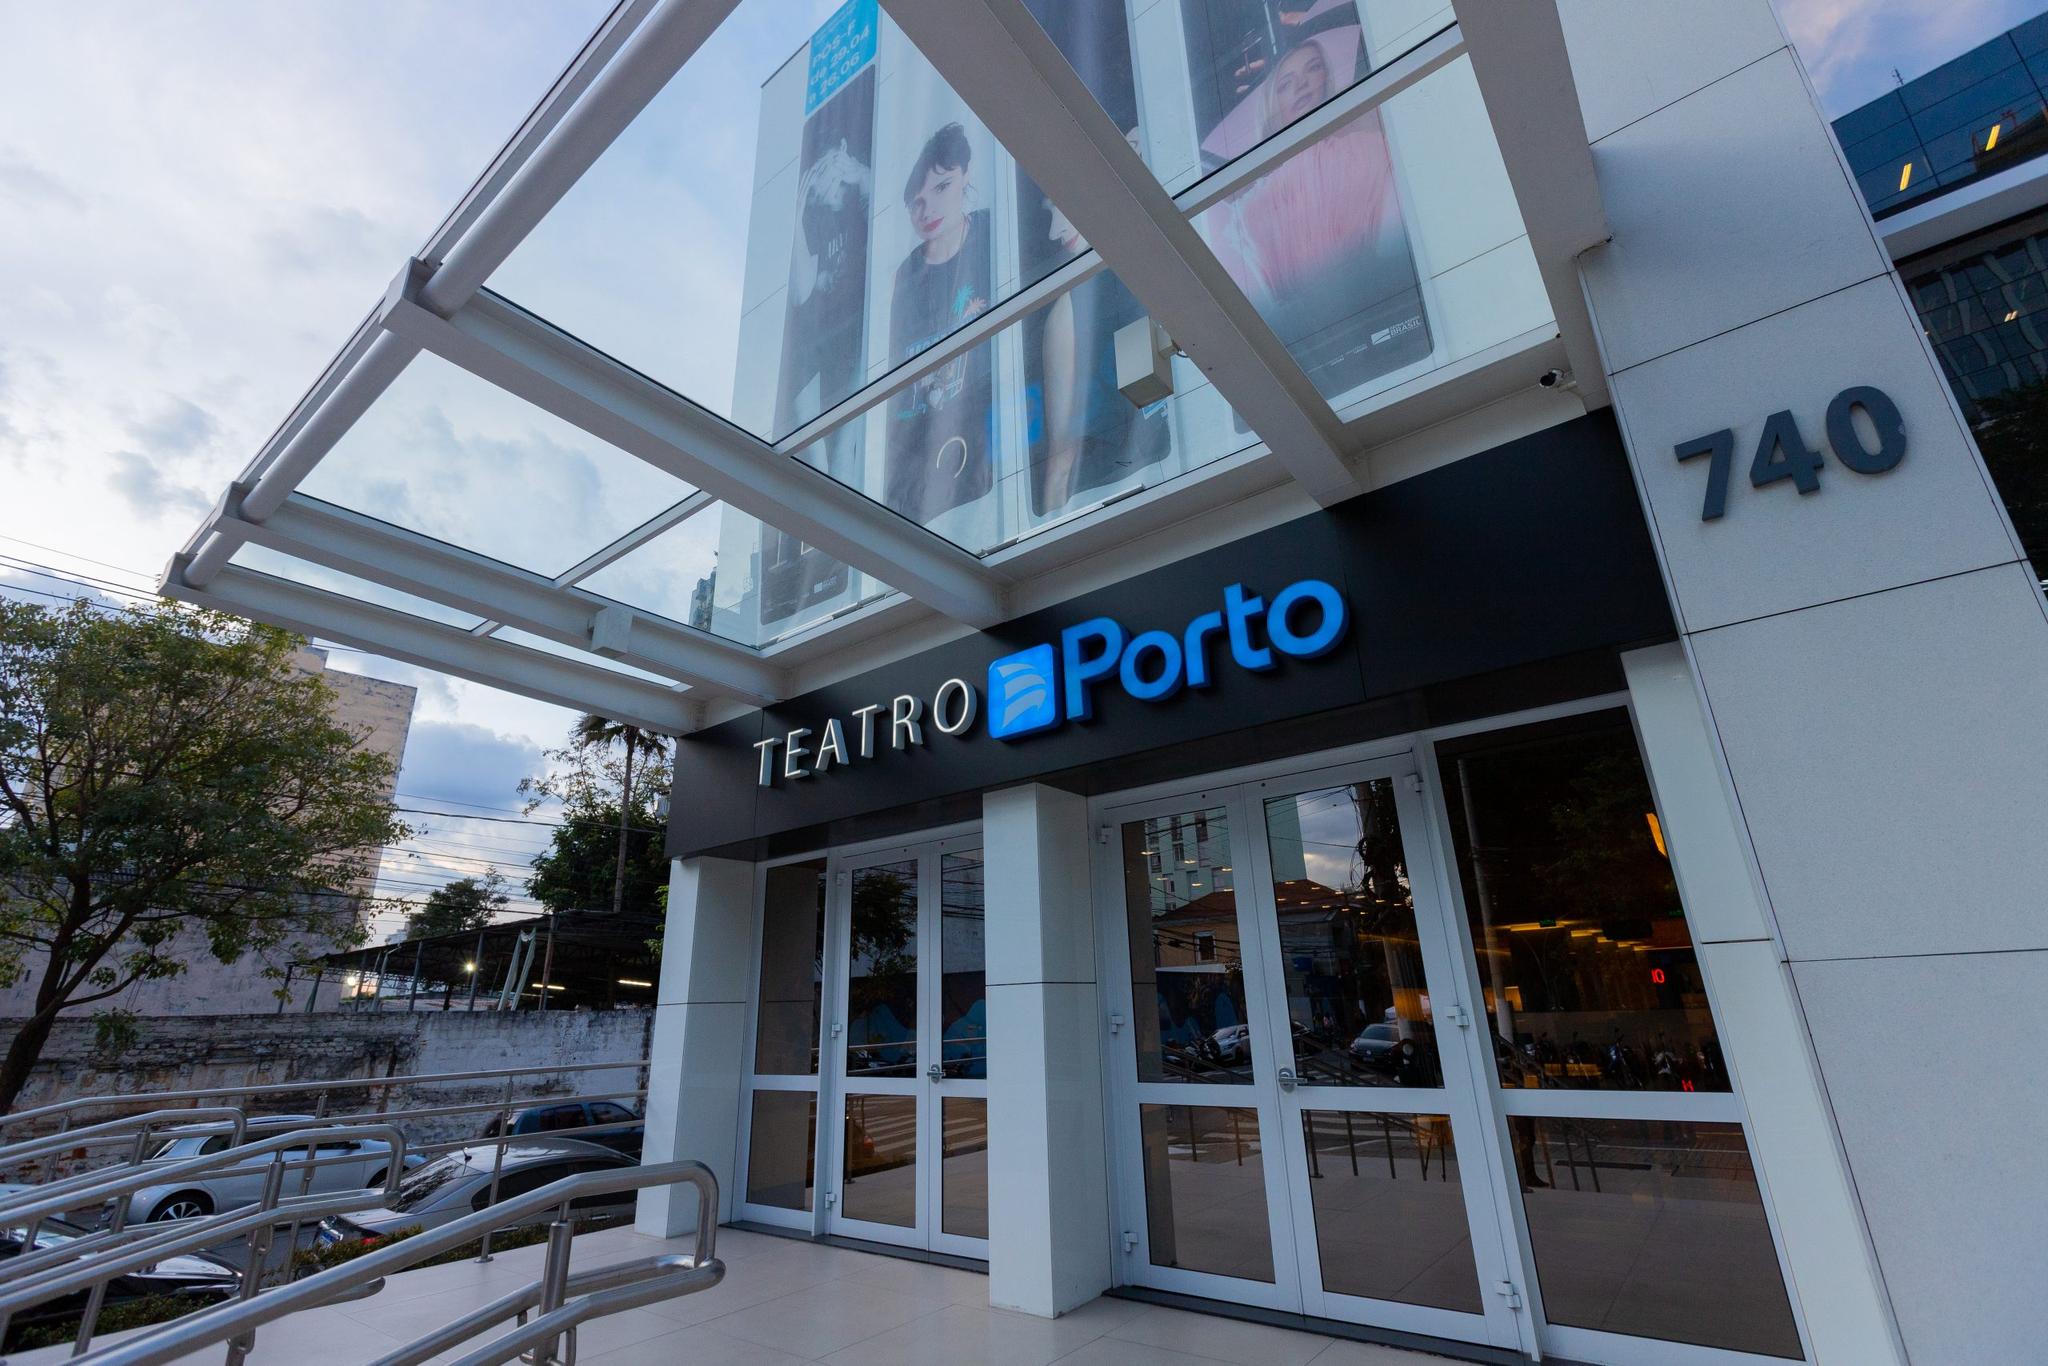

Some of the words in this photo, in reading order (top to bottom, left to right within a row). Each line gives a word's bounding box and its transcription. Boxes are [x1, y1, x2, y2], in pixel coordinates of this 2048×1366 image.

[1674, 385, 1907, 522] 740
[754, 678, 977, 787] TEATRO
[1061, 579, 1350, 723] Porto
